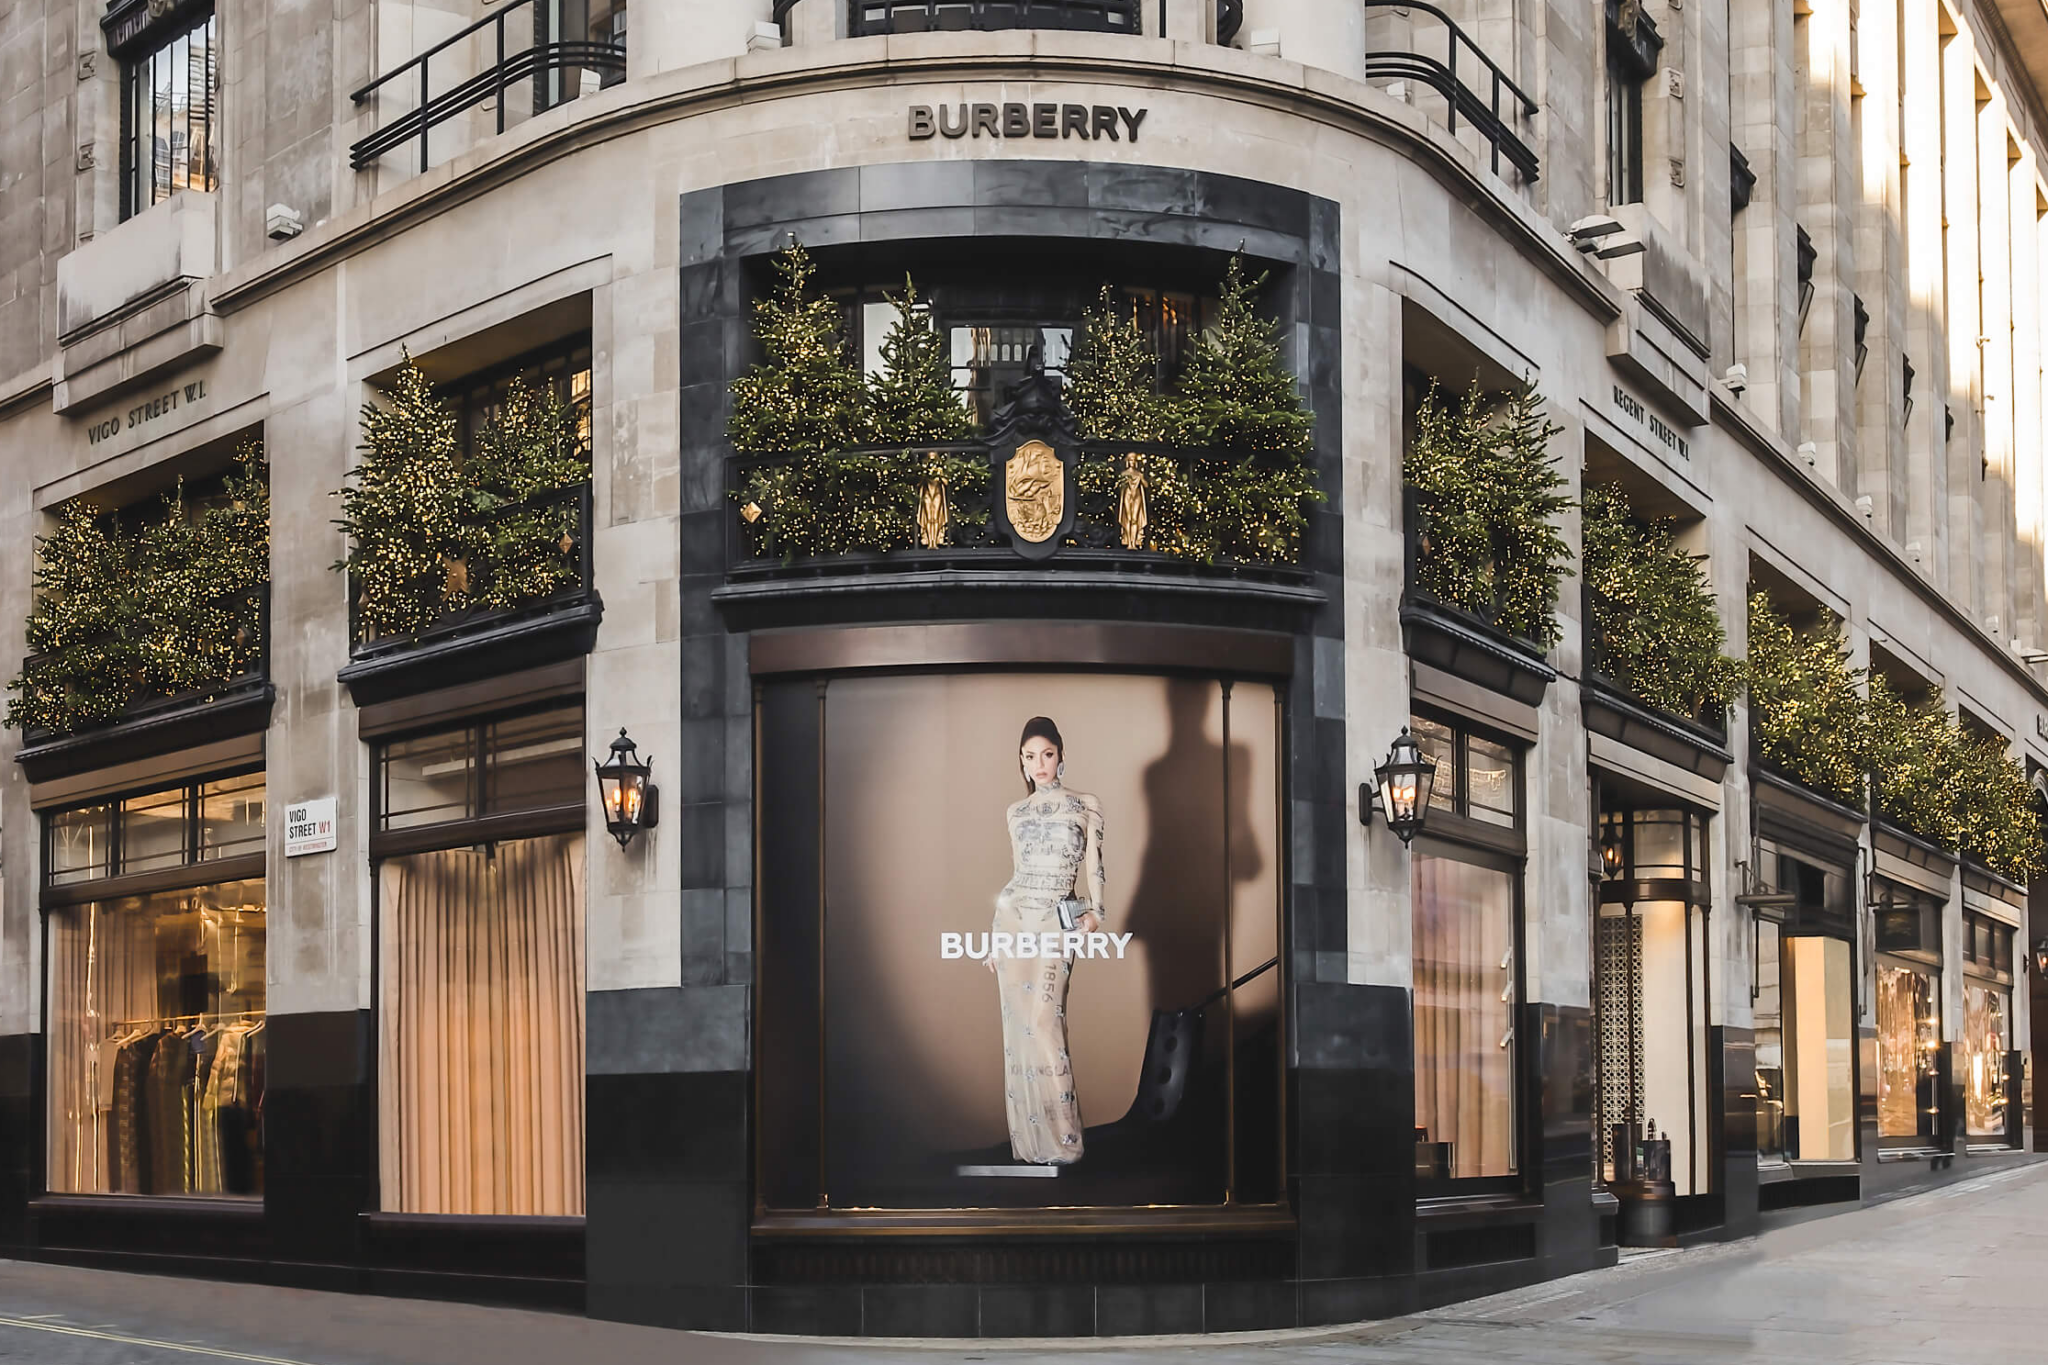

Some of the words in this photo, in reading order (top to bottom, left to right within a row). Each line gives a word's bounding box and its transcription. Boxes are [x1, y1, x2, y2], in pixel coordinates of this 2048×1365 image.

[908, 103, 1148, 143] BURBERRY
[88, 417, 120, 445] VIGO
[128, 390, 179, 429] STREET
[1613, 385, 1644, 424] REGENT
[1650, 415, 1676, 450] STREET
[289, 809, 307, 823] VIGO
[289, 822, 316, 839] STREET
[319, 820, 331, 834] W1
[940, 932, 1134, 959] BURBERRY
[1042, 964, 1057, 1003] 1856
